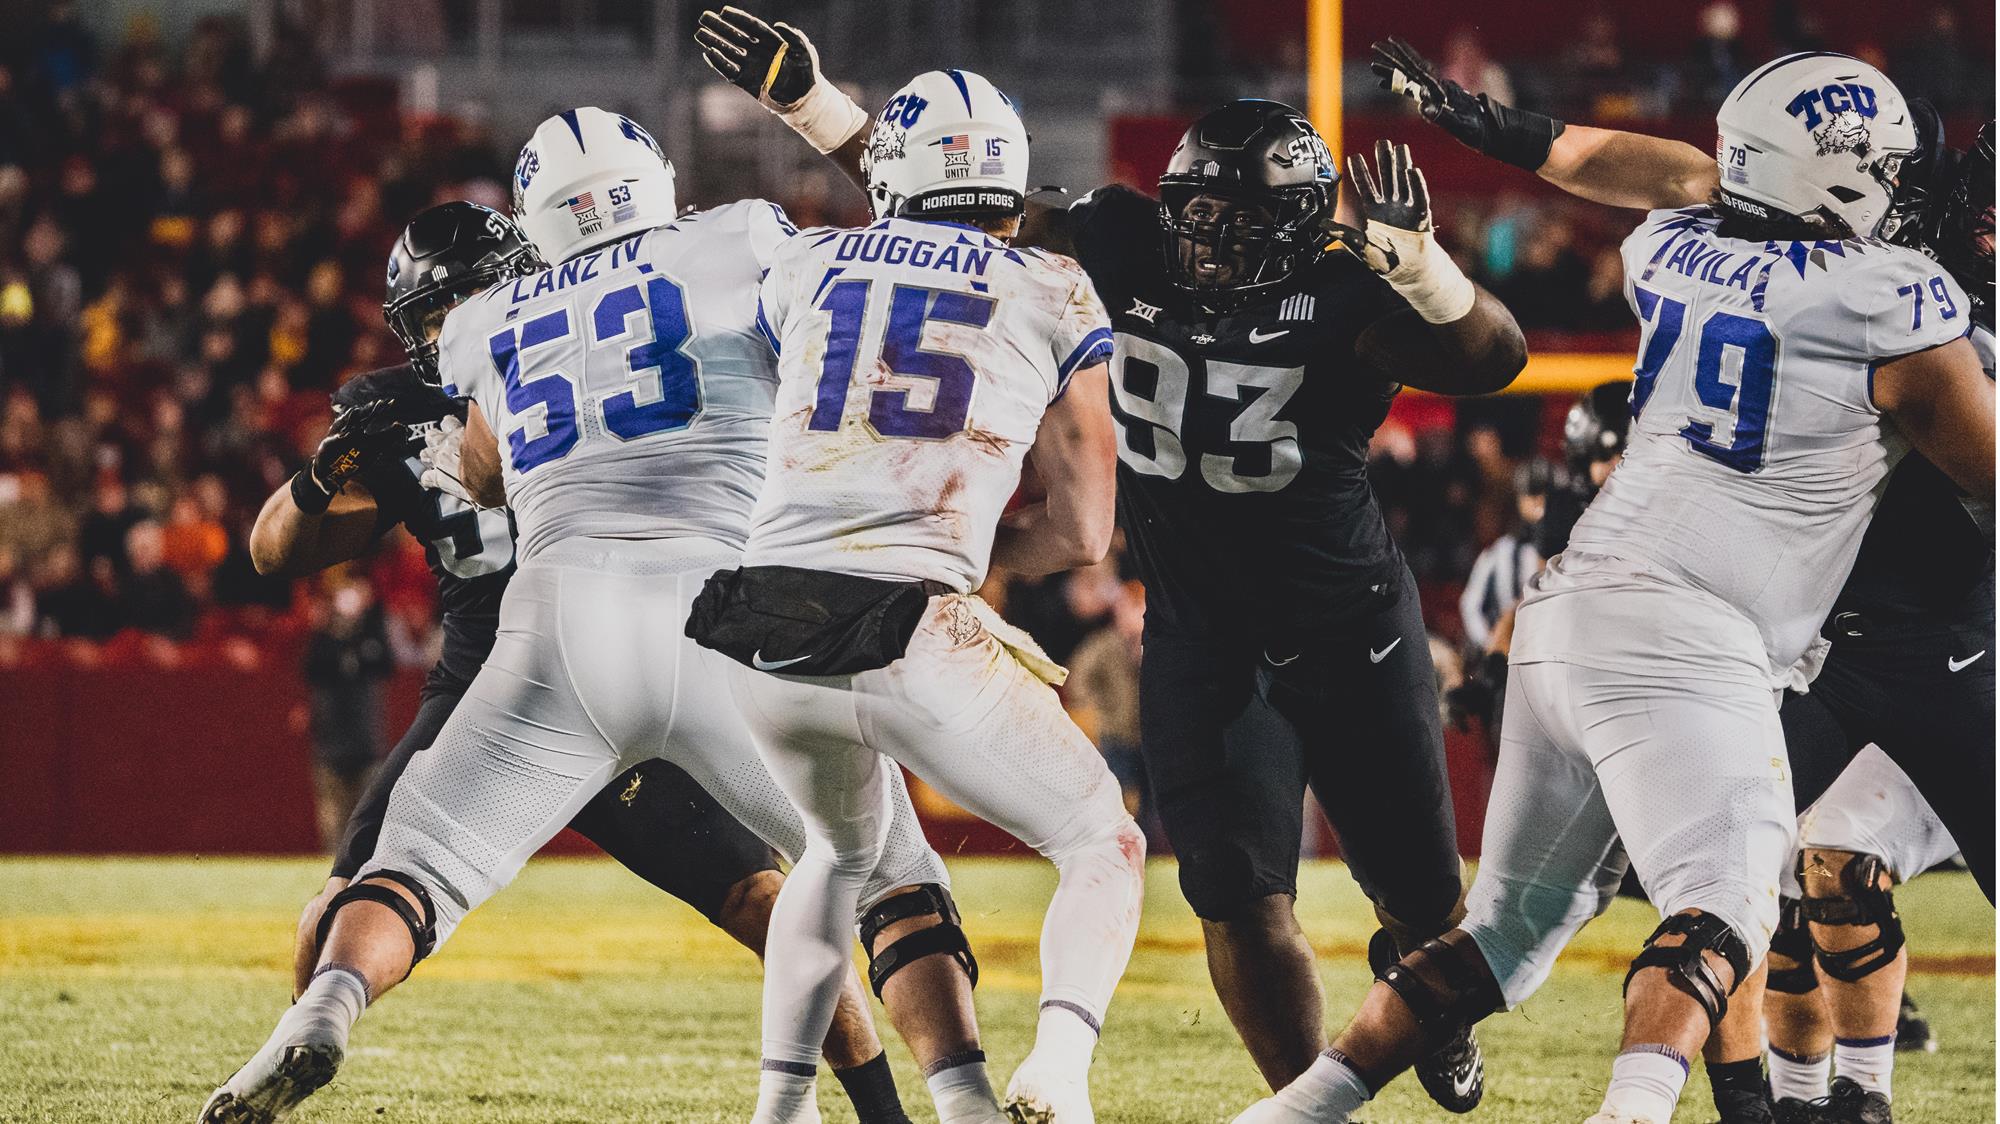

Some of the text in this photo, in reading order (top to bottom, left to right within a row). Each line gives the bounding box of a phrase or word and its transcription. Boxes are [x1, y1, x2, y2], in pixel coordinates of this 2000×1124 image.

[1785, 83, 1879, 132] TCU
[985, 137, 1001, 156] 15
[1730, 145, 1746, 167] 79
[945, 167, 970, 179] UNITY
[608, 185, 632, 206] 53
[922, 193, 1015, 212] HORNED FROGS
[1731, 197, 1768, 218] FROGS
[580, 223, 603, 237] UNITY
[512, 233, 644, 304] LANZ IV
[835, 232, 992, 276] DUGGAN
[1666, 237, 1761, 292] AVILA
[1125, 297, 1164, 324] XII
[1896, 274, 1958, 336] 79
[487, 273, 706, 477] 53
[807, 278, 999, 443] 15
[1629, 285, 1785, 476] 79
[1107, 331, 1305, 493] 93
